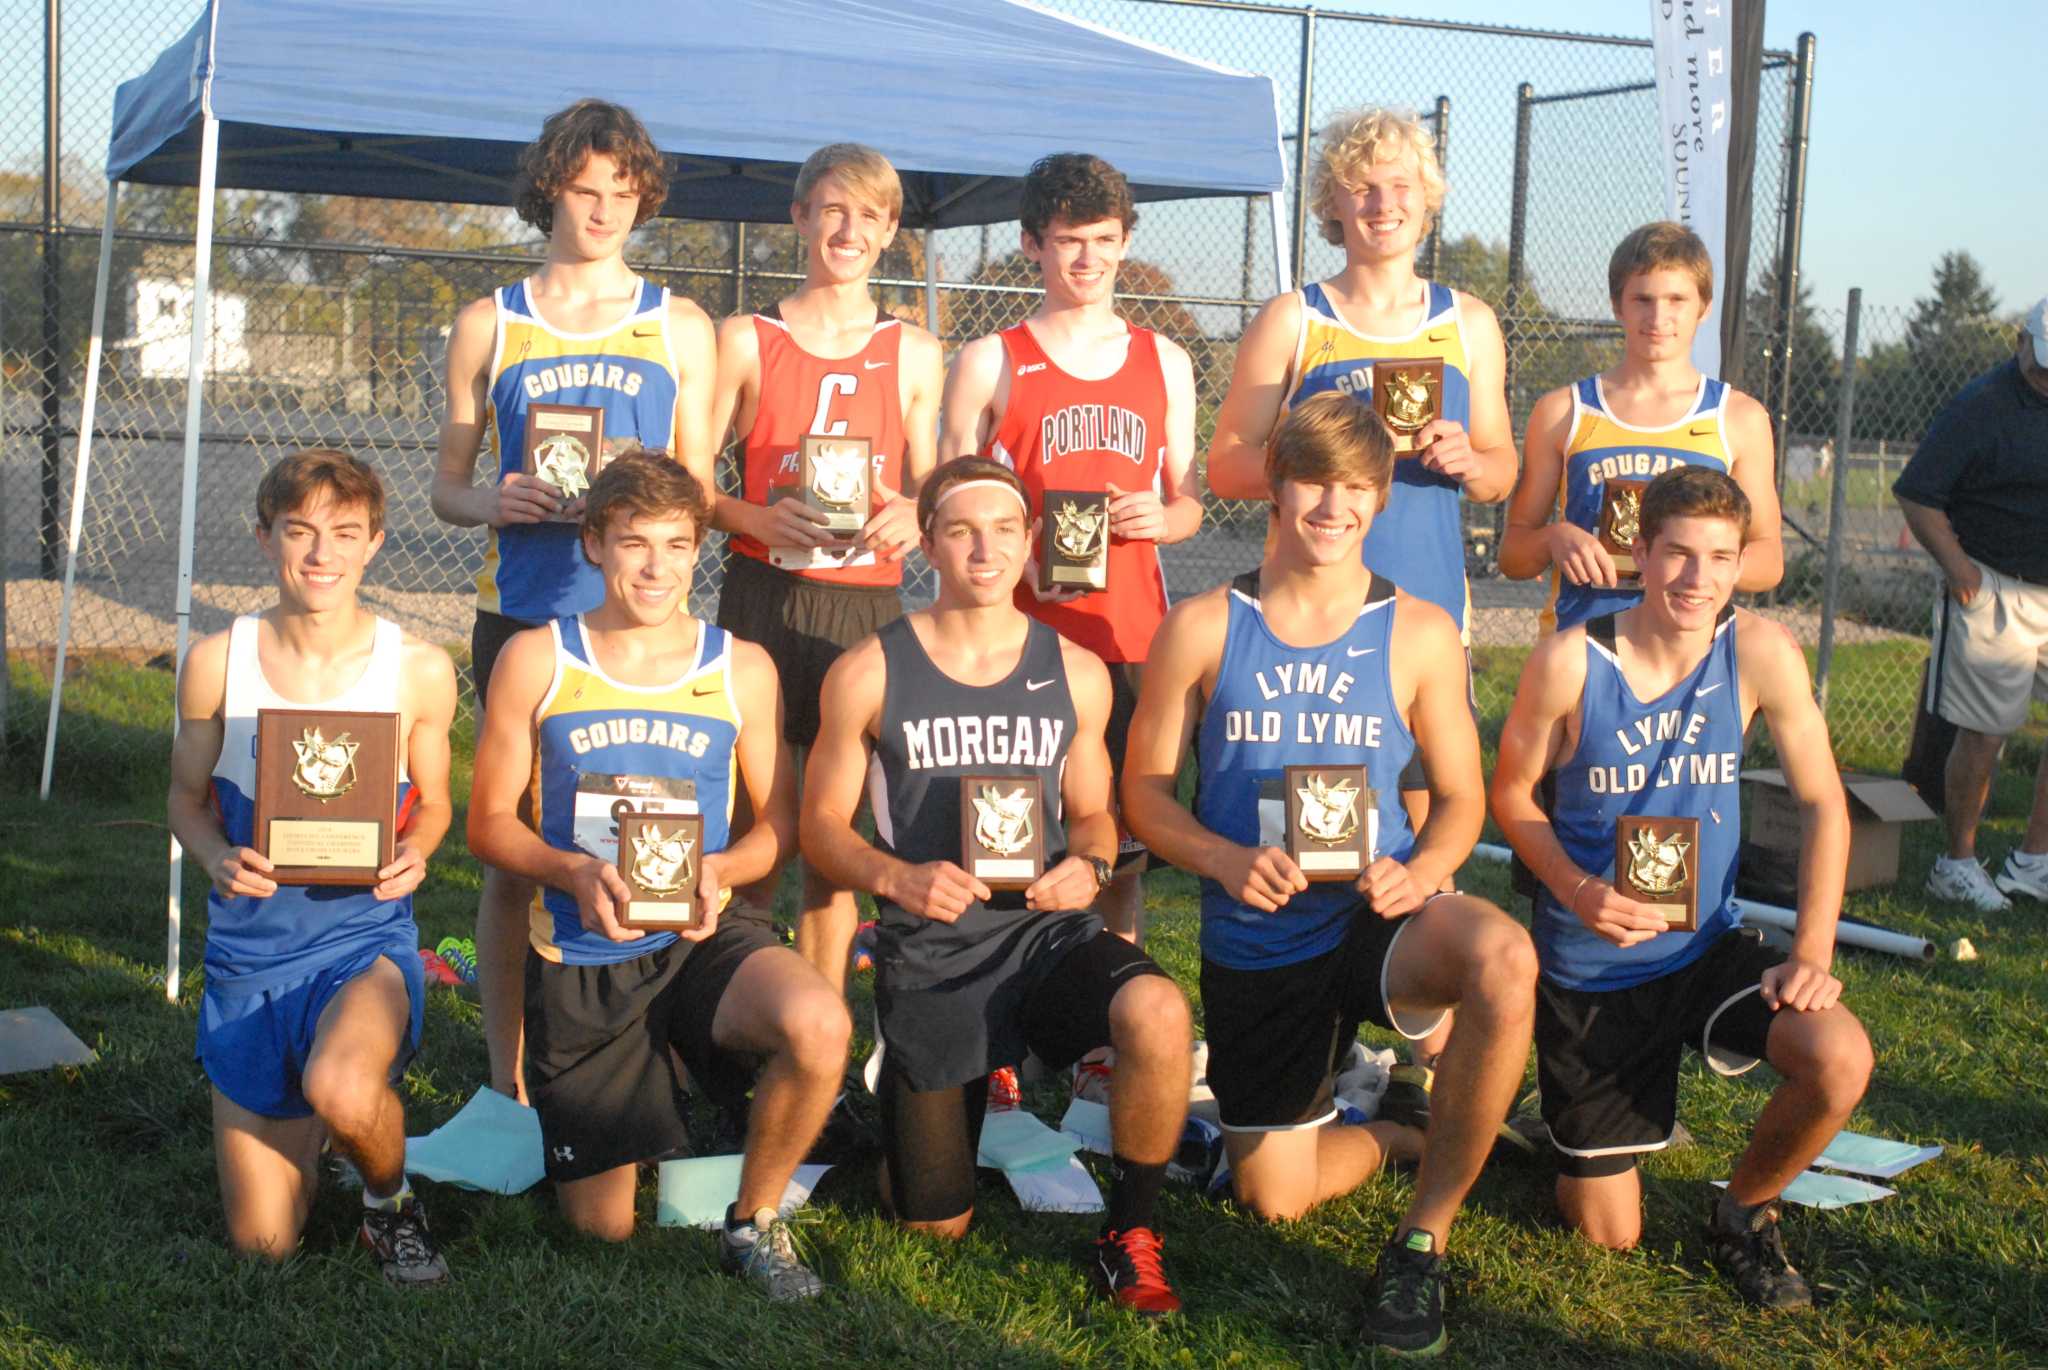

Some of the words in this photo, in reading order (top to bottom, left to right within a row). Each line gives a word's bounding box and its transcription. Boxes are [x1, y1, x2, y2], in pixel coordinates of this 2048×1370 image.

[1686, 53, 1704, 153] more
[524, 362, 643, 399] COUGARS
[808, 372, 859, 436] C
[1042, 404, 1146, 465] PORTLAND
[1255, 662, 1355, 704] LYME
[569, 717, 711, 759] COUGARS
[902, 715, 1064, 770] MORGAN
[1225, 710, 1281, 743] OLD
[1297, 712, 1383, 748] LYME
[1615, 709, 1707, 757] LYME
[1588, 763, 1647, 794] OLD
[1655, 752, 1736, 788] LYME
